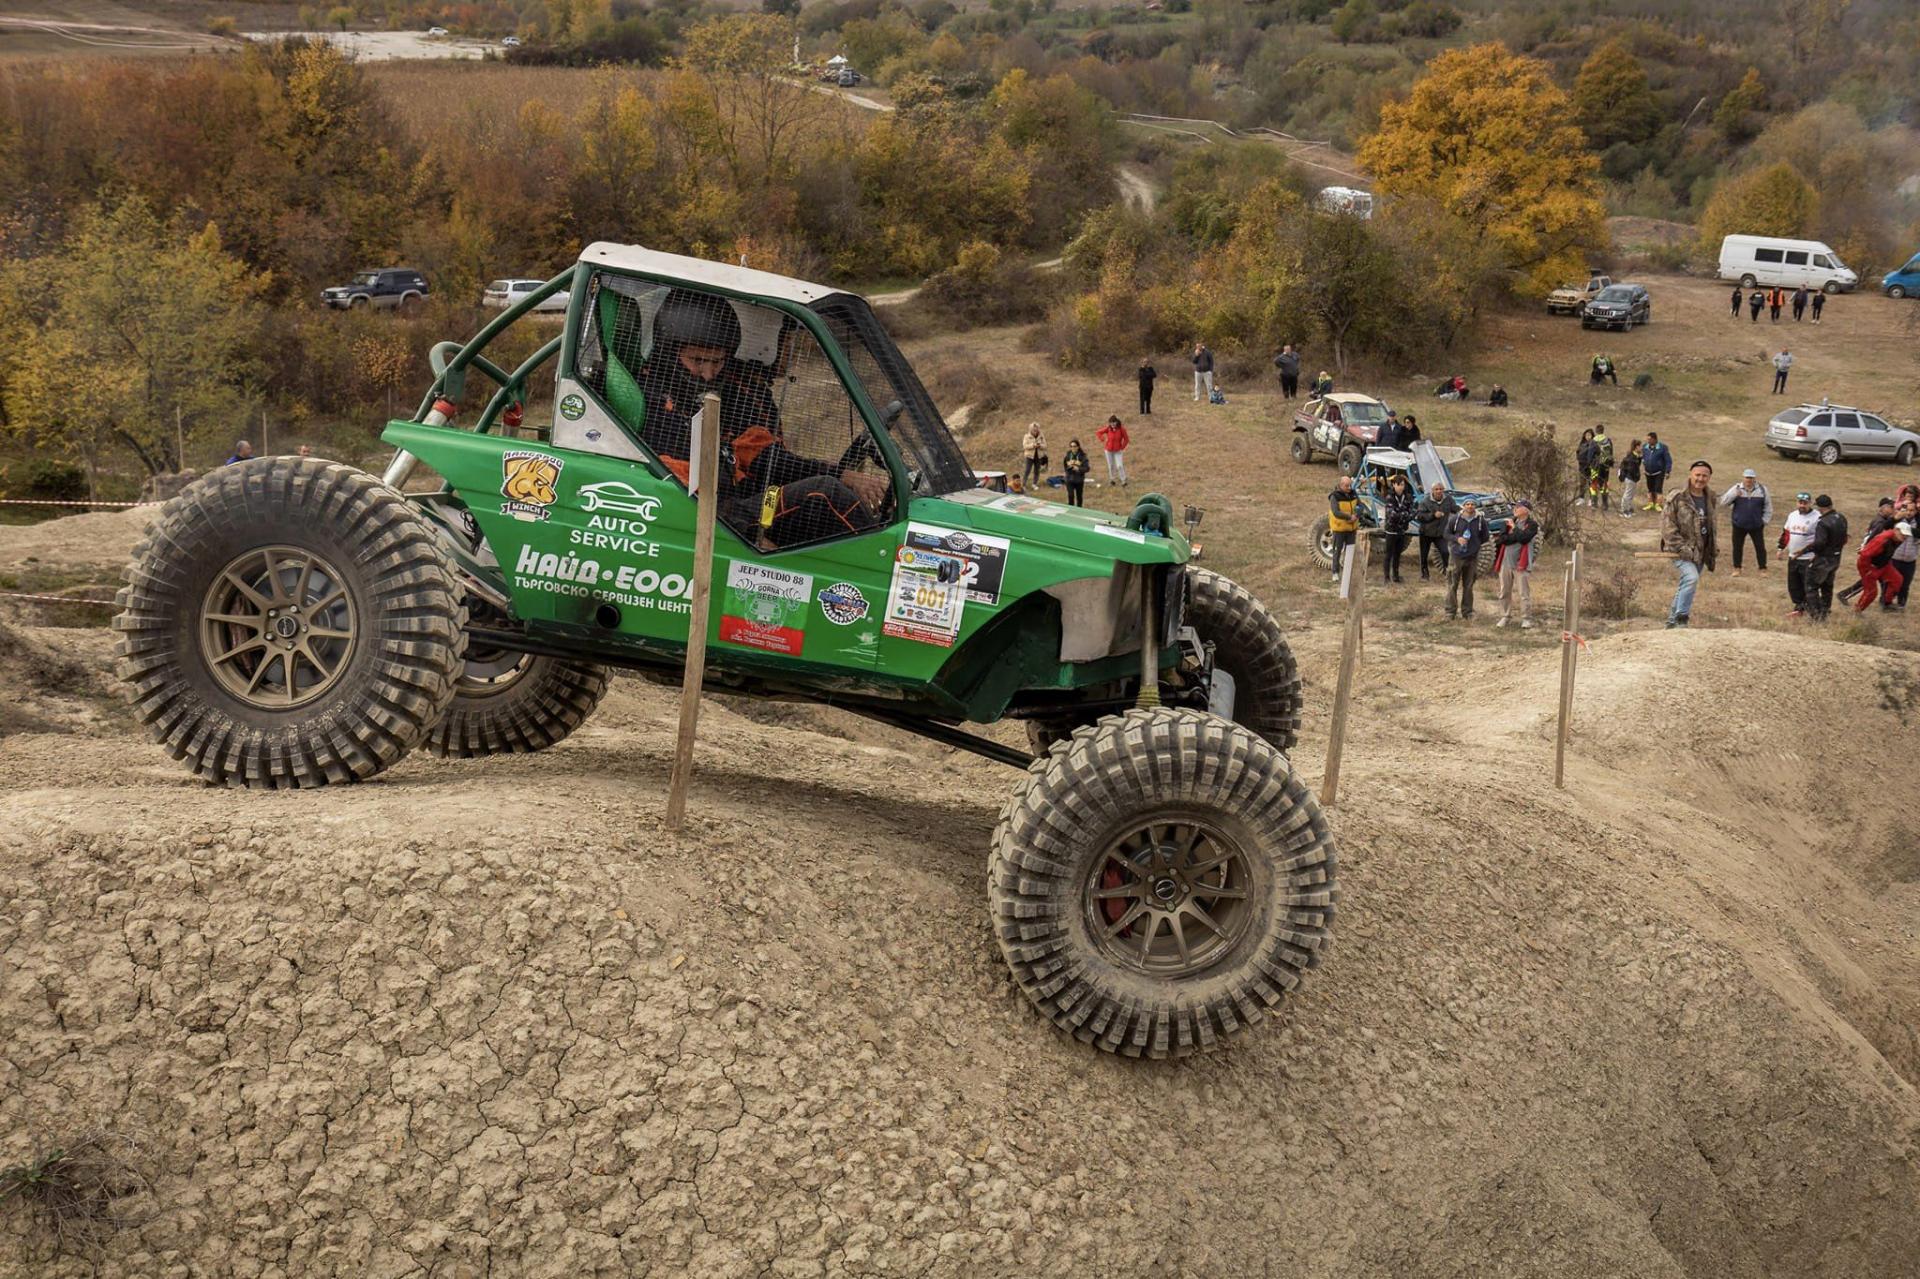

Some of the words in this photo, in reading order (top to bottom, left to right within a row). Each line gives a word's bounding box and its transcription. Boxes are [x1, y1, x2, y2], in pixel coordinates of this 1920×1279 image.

[512, 503, 541, 514] WINCH
[587, 514, 648, 536] AUTO
[569, 529, 660, 558] SERVICE
[738, 565, 759, 576] JEEP
[760, 568, 791, 583] STUDIO
[793, 575, 804, 585] 88
[514, 576, 589, 597] ТЪРГОВСКО
[592, 589, 654, 609] СЕРВИЗЕН
[757, 585, 781, 595] GORNA
[917, 584, 945, 608] 001
